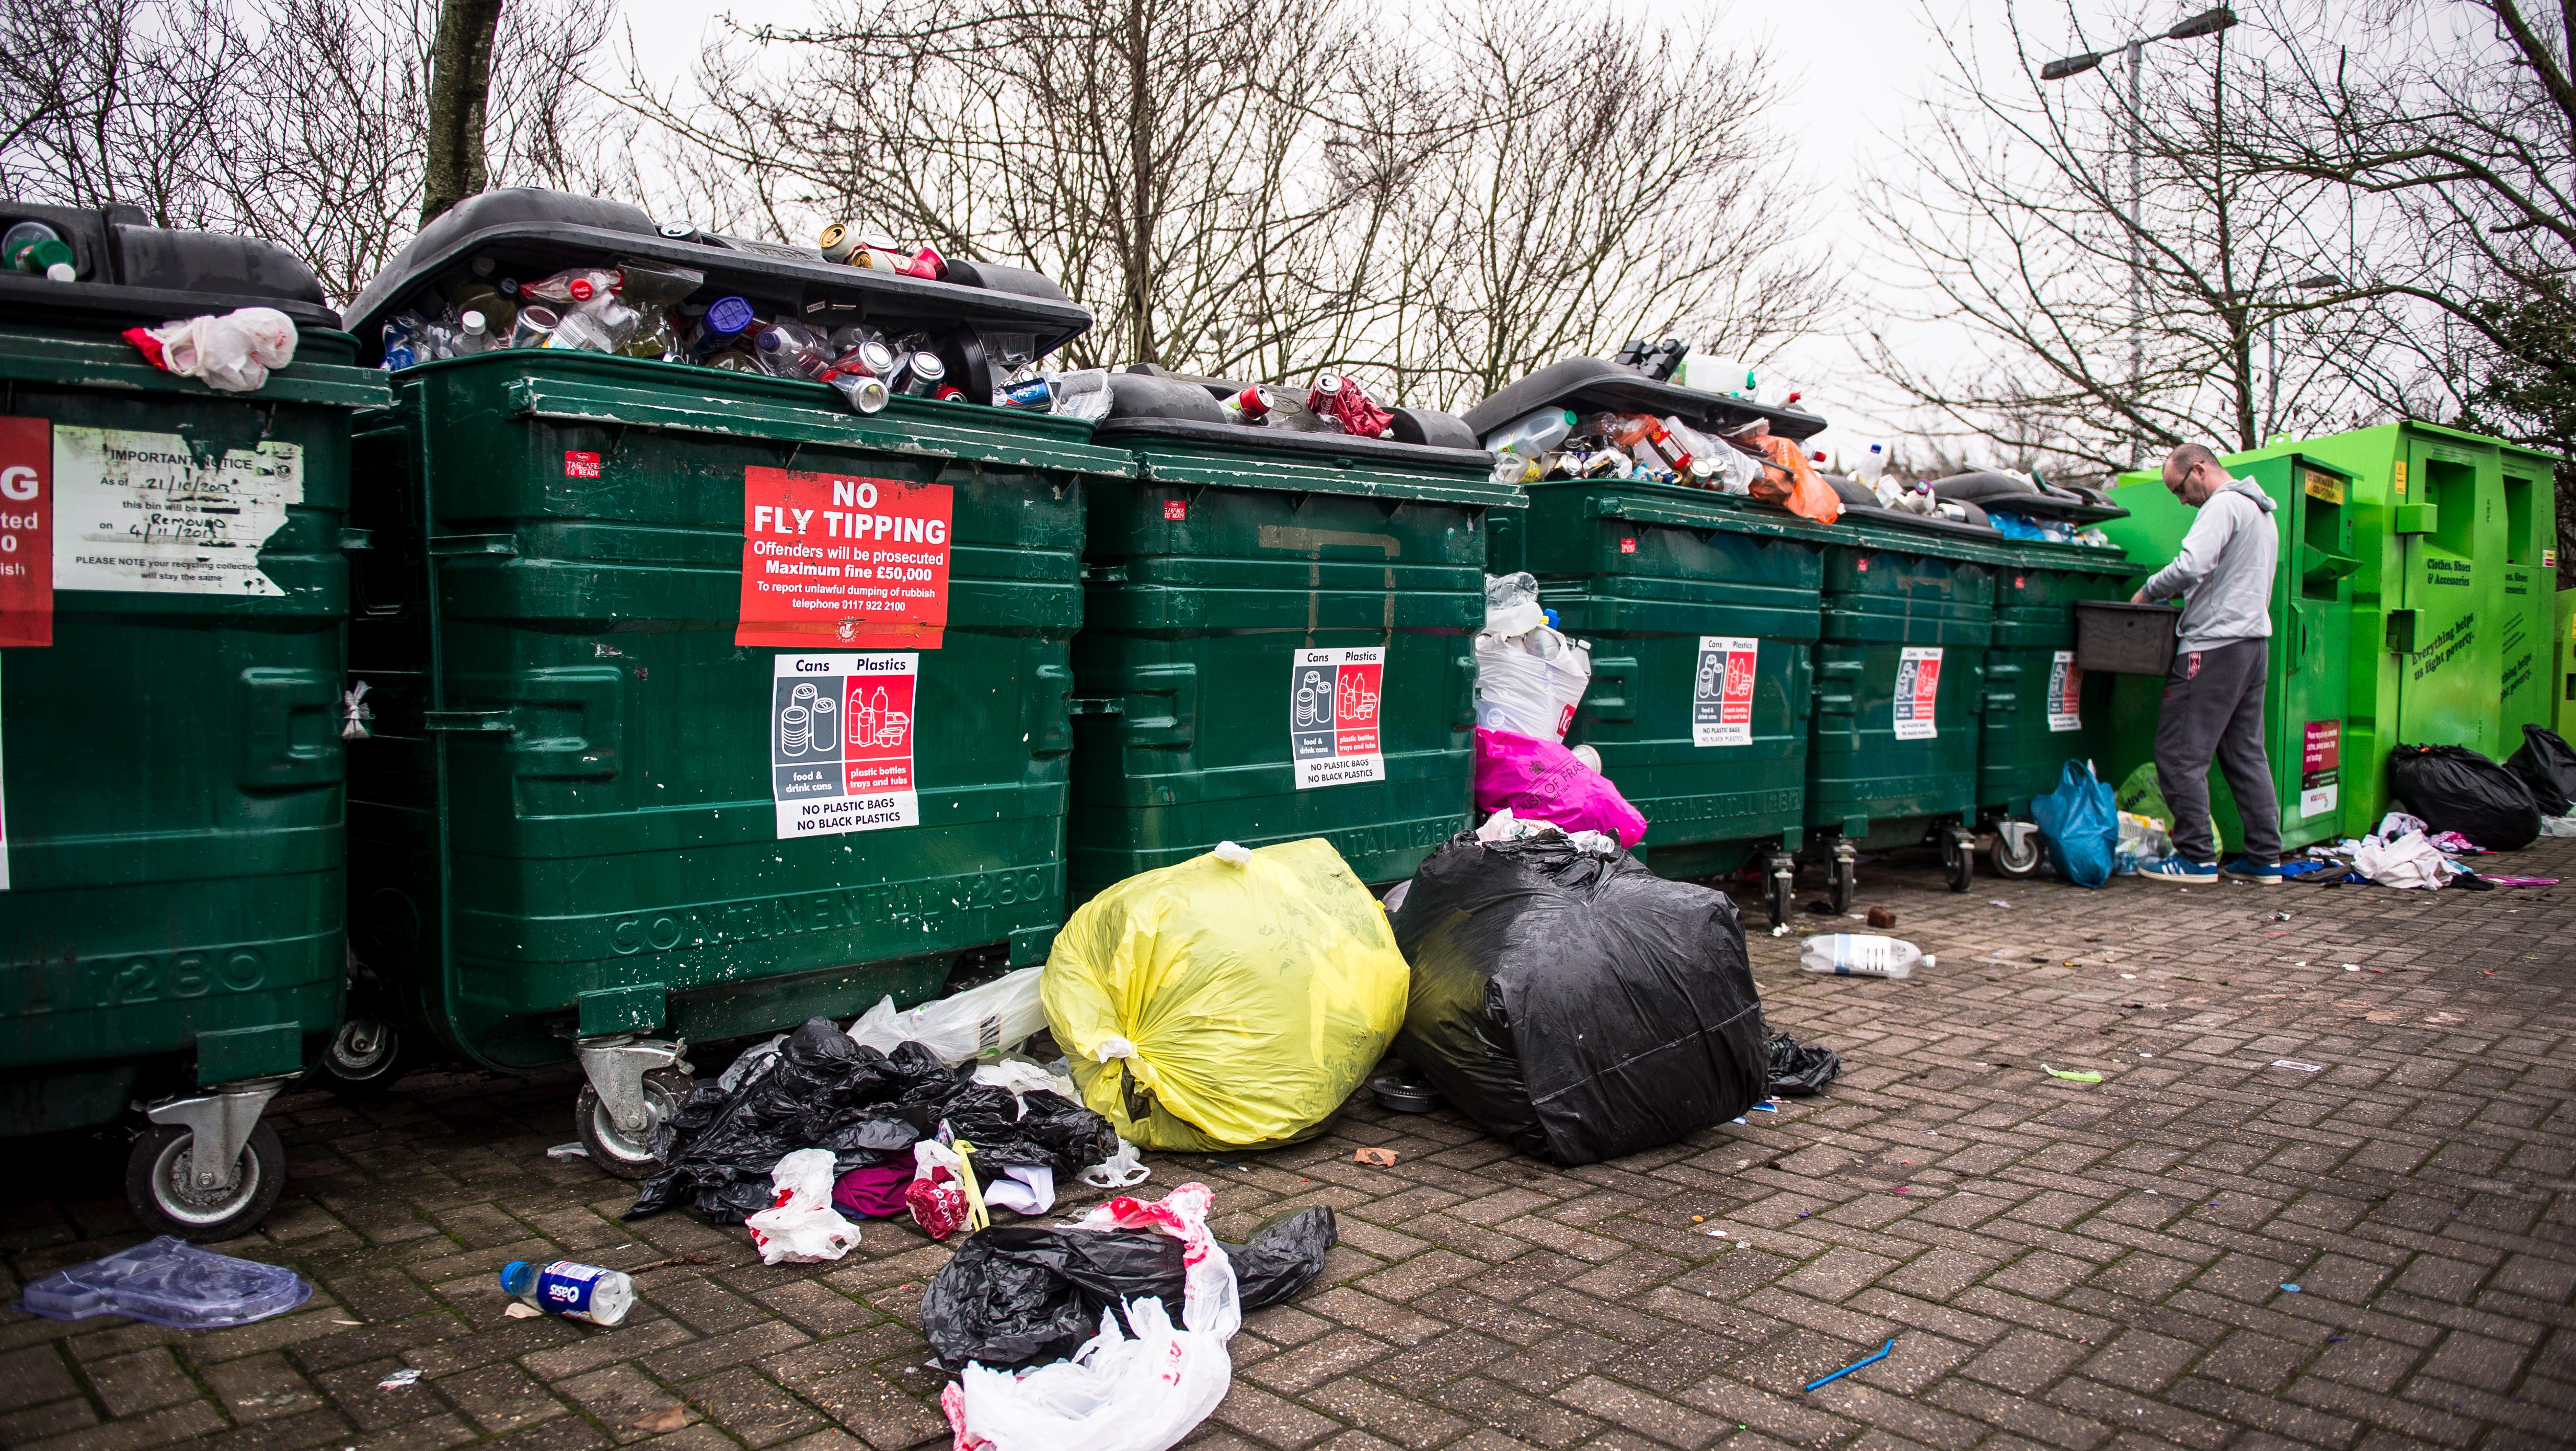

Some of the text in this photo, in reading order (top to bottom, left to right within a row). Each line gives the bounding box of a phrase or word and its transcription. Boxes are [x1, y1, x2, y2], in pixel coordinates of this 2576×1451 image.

[110, 449, 196, 466] IMPORTANT
[100, 477, 129, 486] As of
[833, 480, 878, 508] NO
[122, 500, 142, 509] this
[145, 501, 162, 510] bin
[754, 505, 945, 544] FLY TIPPING
[754, 541, 943, 565] Offenders will be prosecuted
[76, 556, 117, 566] PLEASE
[118, 558, 145, 567] NOTE
[148, 560, 169, 568] your
[171, 559, 214, 570] recycling
[2428, 559, 2471, 573] Clothes, Shoes
[141, 572, 158, 580] will
[159, 573, 179, 582] stay
[181, 573, 196, 581] the
[766, 560, 932, 582] Maximum fine £50,000
[2435, 574, 2469, 586] Accessories
[757, 580, 935, 598] To report unlawful dumping of rubbish
[792, 598, 905, 611] telephone 0117 922 2100
[2412, 627, 2455, 666] Everything
[2455, 613, 2474, 634] helps
[1307, 653, 1328, 662] Cans
[1346, 652, 1377, 661] Plastics
[2414, 631, 2475, 681] us fight poverty.
[796, 659, 830, 672] Cans
[857, 658, 906, 670] Plastics
[794, 771, 823, 781] food &
[850, 766, 906, 779] plastic bottles
[1322, 772, 1342, 781] BLACK
[1344, 769, 1373, 779] PLASTICS
[1545, 778, 1559, 793] OF
[1561, 761, 1585, 782] FRAS
[786, 783, 832, 793] drink cans
[850, 780, 870, 790] trays
[872, 778, 888, 786] and
[1547, 784, 1570, 804] SINCE 1849
[802, 798, 894, 815] NO PLASTIC BAGS
[797, 812, 900, 830] NO BLACK PLASTICS
[610, 867, 1046, 954] CONTINENTAL 1280
[549, 1284, 580, 1303] Oasis
